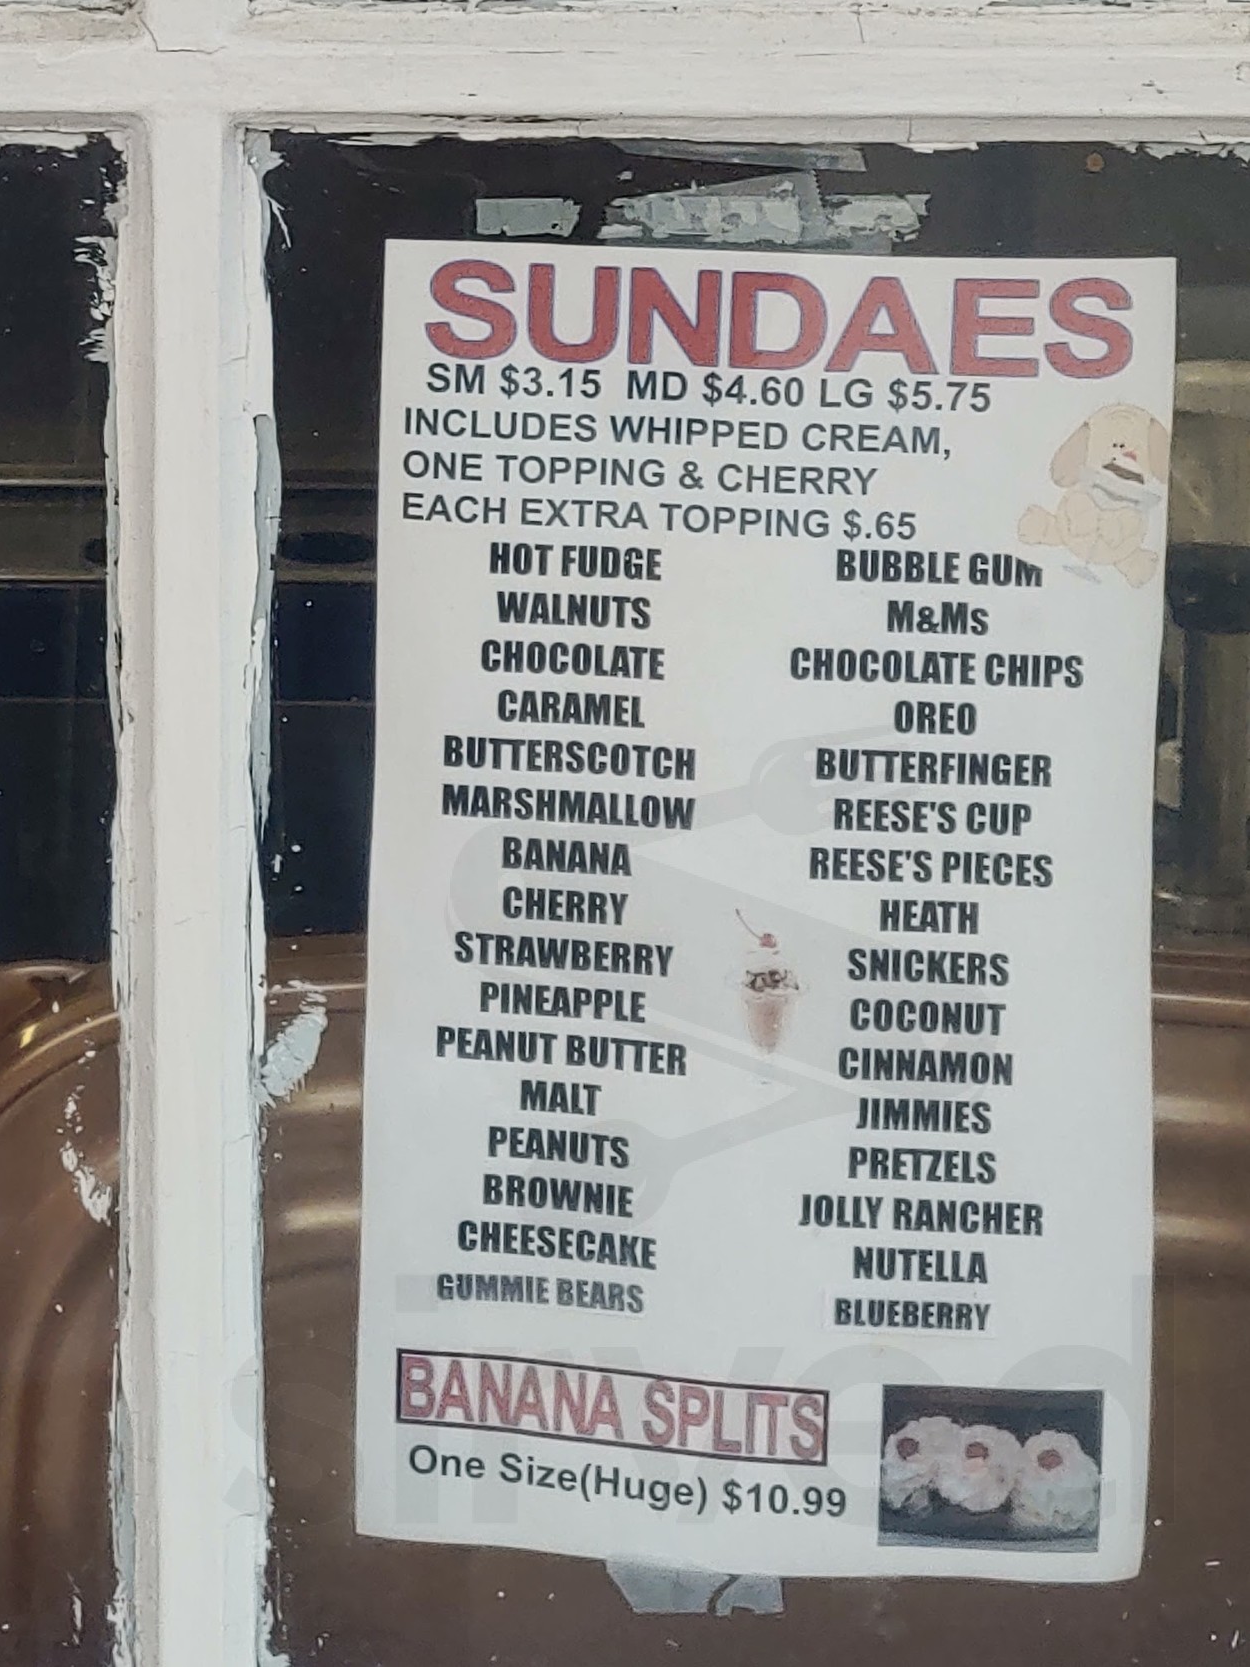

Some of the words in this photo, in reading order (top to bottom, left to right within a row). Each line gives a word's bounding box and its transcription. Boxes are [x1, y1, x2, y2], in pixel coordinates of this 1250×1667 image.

[425, 259, 1133, 379] SUNDAES
[426, 363, 485, 394] SM
[500, 363, 601, 399] $3.15
[627, 370, 688, 401] MD
[702, 372, 804, 407] $4.60
[820, 379, 873, 409] LG
[888, 380, 991, 413] $5.75
[403, 408, 598, 442] INCLUDES
[610, 415, 787, 450] WHIPPED
[803, 422, 951, 460] CREAM,
[403, 492, 506, 524] EACH
[521, 498, 648, 529] EXTRA
[659, 503, 829, 538] TOPPING
[843, 509, 916, 542] $.65
[837, 549, 960, 584] BUBBLE
[969, 553, 1042, 587] GUM
[791, 647, 976, 685] CHOCOLATE
[985, 653, 1083, 688] CHIPS
[444, 735, 695, 780] BUTTERSCOTCH
[834, 798, 956, 834] REESE'S
[966, 802, 1031, 836] CUP
[503, 886, 628, 925] CHERRY
[455, 931, 673, 977] STRAWBERRY
[480, 982, 645, 1023] PINEAPPLE
[437, 1026, 558, 1064] PEANUT
[566, 1035, 686, 1076] BUTTER
[489, 1126, 629, 1168] PEANUTS
[483, 1174, 633, 1218] BROWNIE
[458, 1220, 656, 1270] CHEESECAKE
[437, 1273, 549, 1304] GUMMIE
[556, 1278, 643, 1313] BEARS
[400, 1354, 623, 1440] BANANA
[642, 1380, 824, 1461] SPLITS
[409, 1445, 485, 1478] One
[722, 1480, 847, 1517] $10.99
